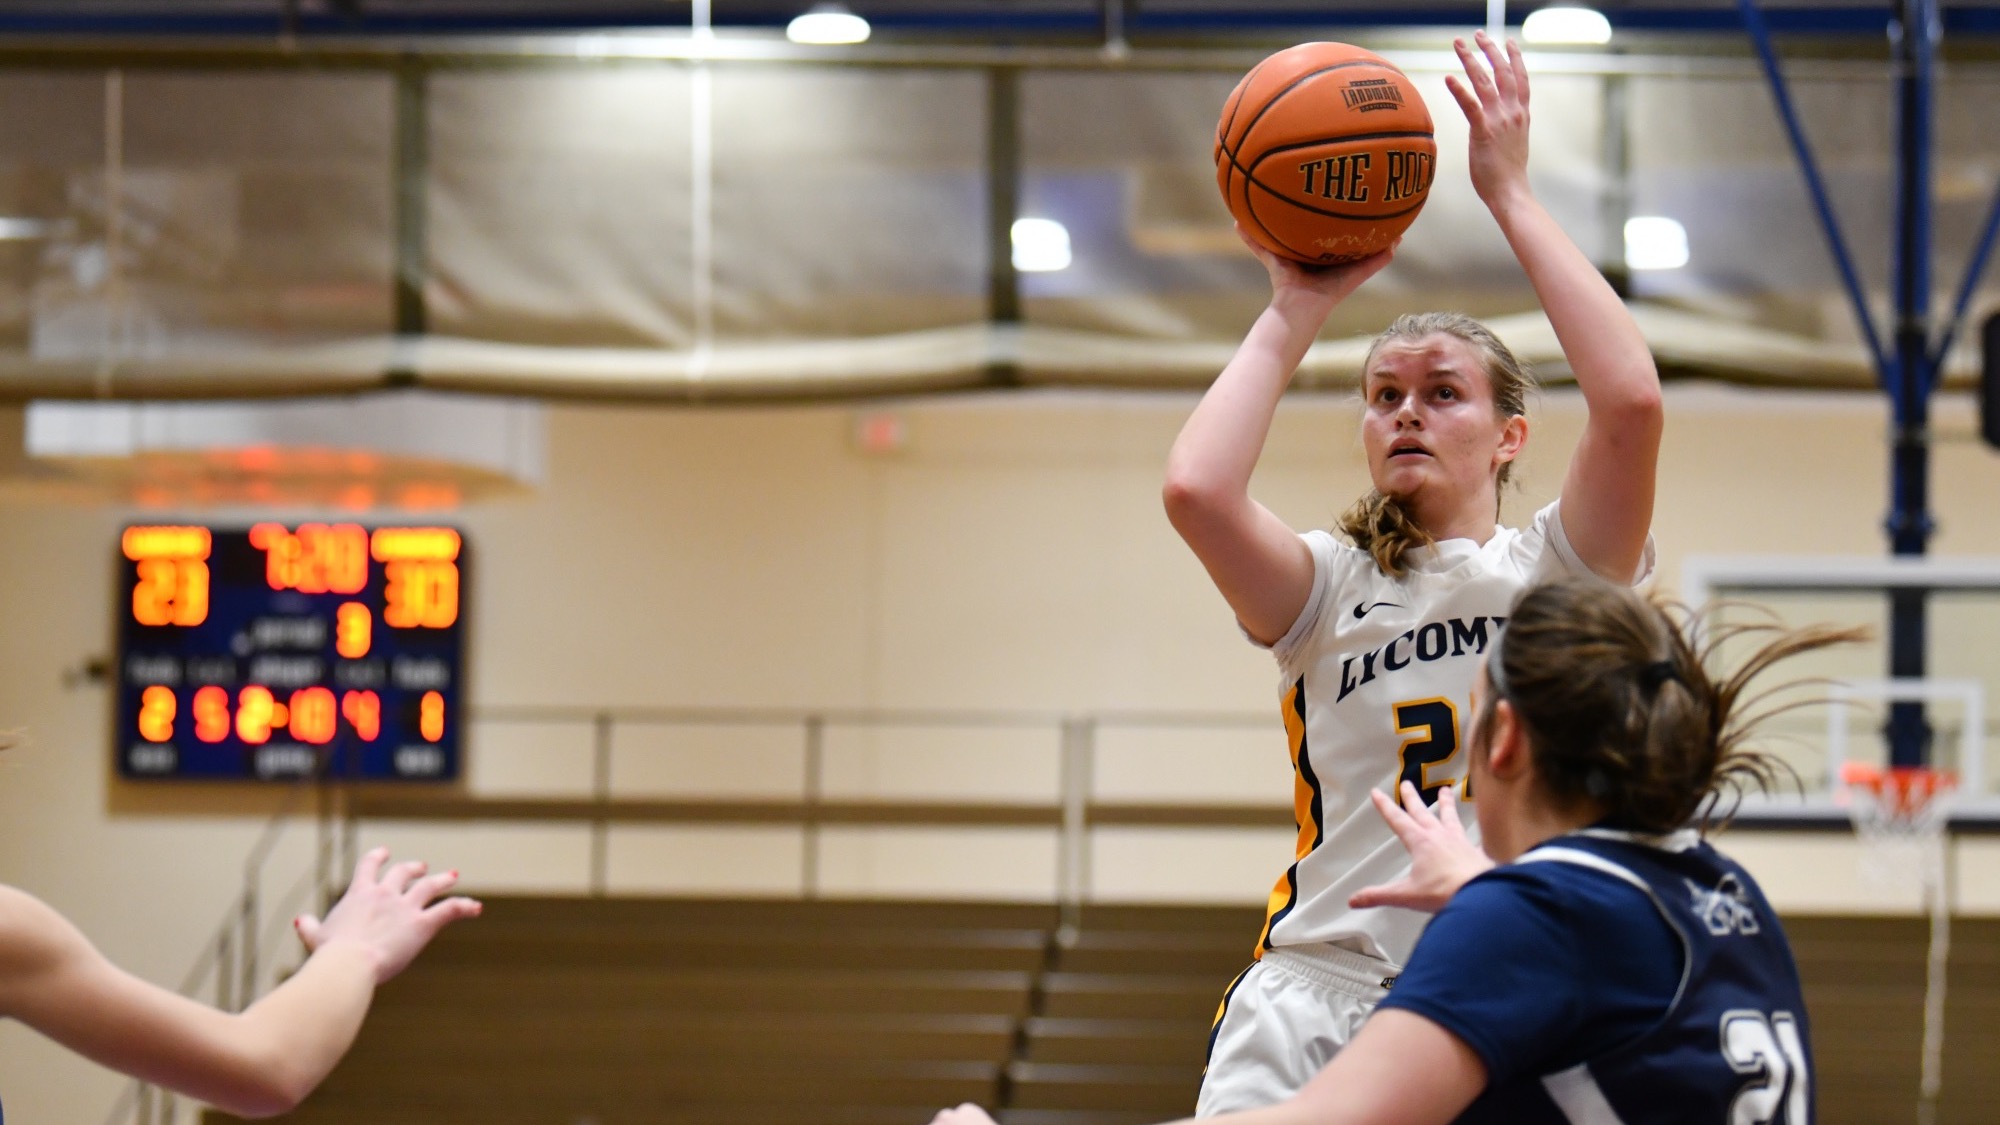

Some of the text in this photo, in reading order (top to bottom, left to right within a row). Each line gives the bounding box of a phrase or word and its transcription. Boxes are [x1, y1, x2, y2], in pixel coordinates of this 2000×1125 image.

[1299, 152, 1371, 203] THE
[383, 560, 460, 628] 30
[1392, 692, 1474, 810] 2
